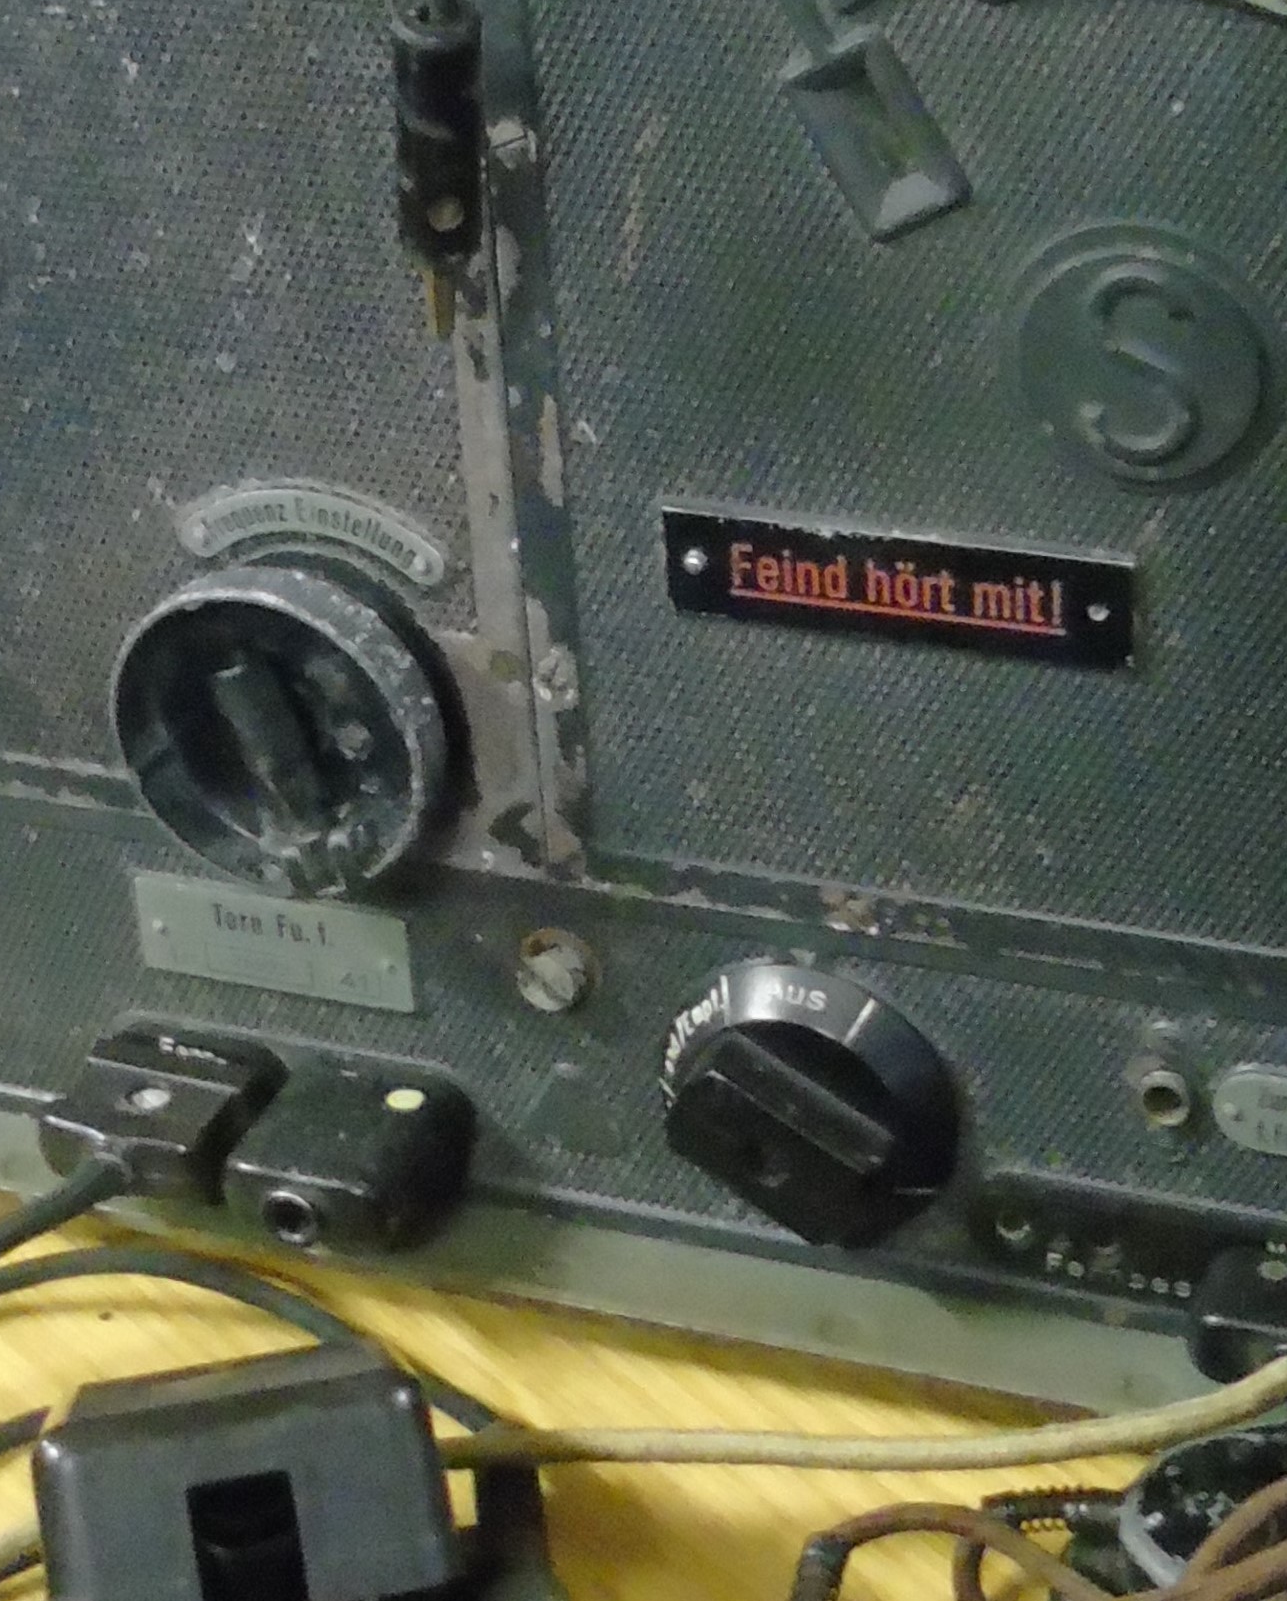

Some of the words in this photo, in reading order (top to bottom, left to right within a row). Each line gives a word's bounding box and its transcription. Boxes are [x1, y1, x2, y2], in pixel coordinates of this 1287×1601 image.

[1077, 257, 1202, 469] S
[294, 498, 418, 571] Einstellung
[730, 541, 848, 598] Feind
[866, 556, 958, 613] hört
[973, 575, 1065, 627] mit!
